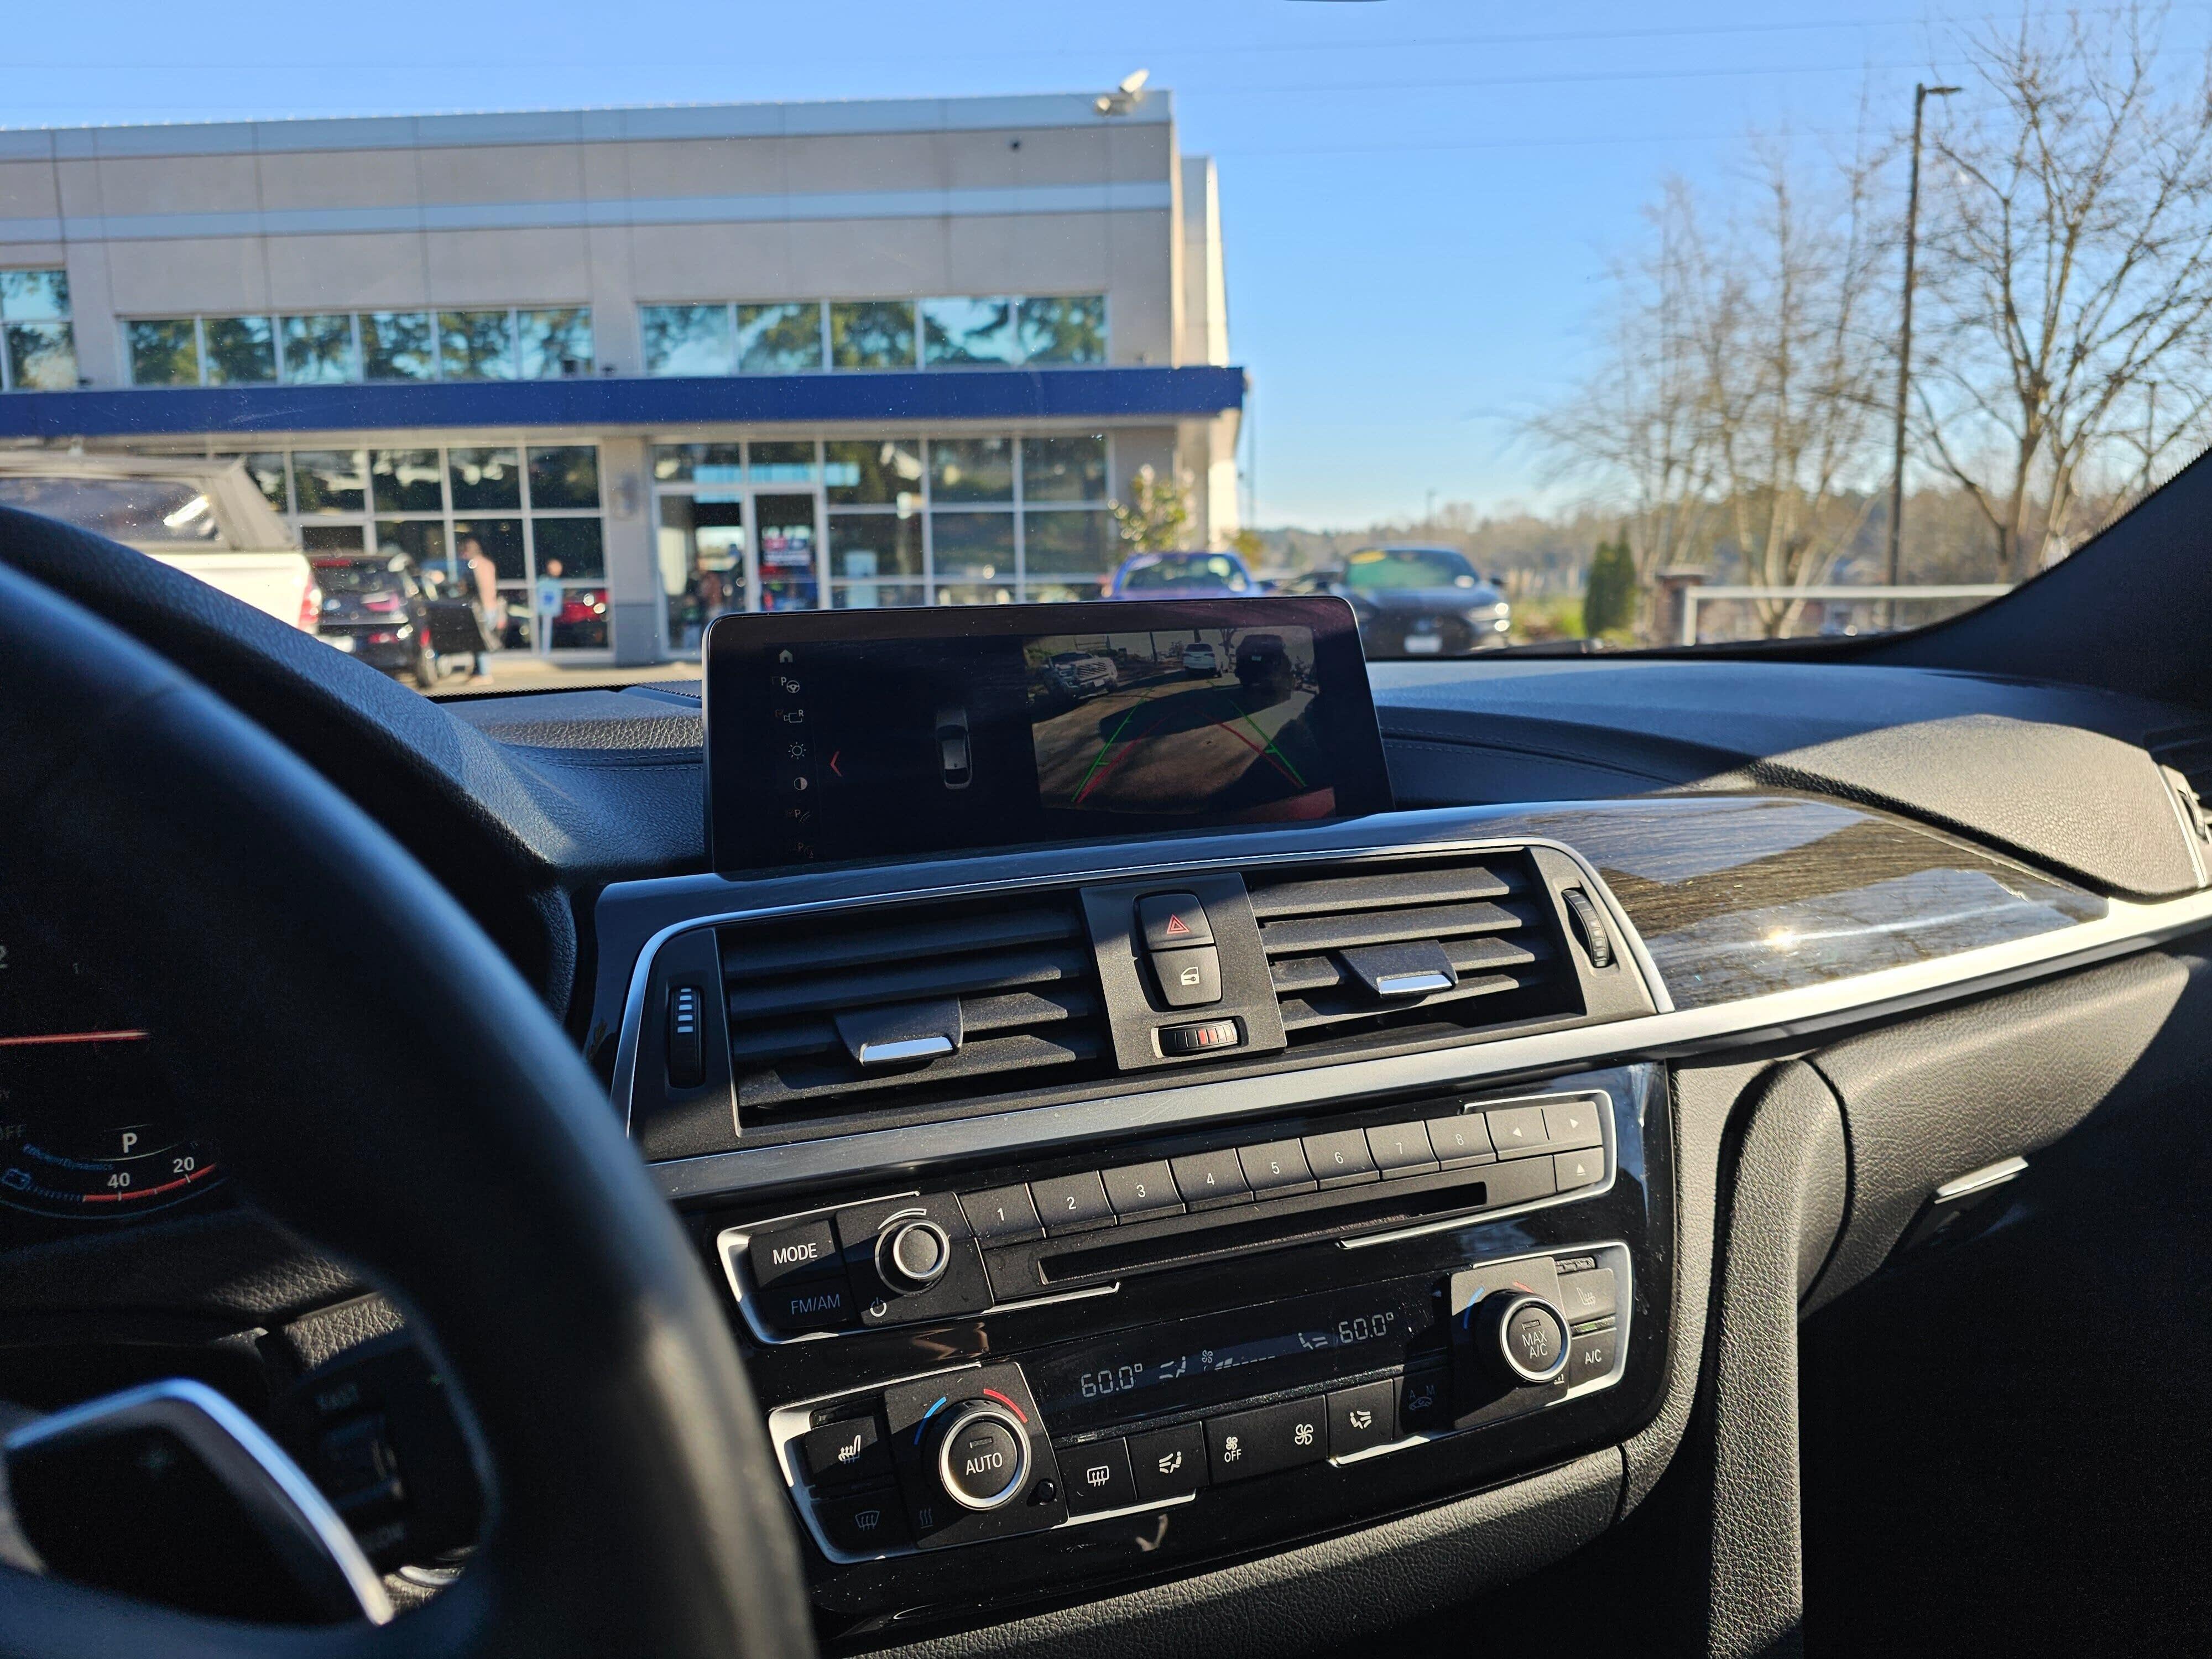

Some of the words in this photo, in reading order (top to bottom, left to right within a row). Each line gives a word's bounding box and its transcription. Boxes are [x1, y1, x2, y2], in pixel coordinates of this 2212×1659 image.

[781, 676, 787, 686] P
[798, 709, 805, 718] R
[795, 809, 801, 818] P
[122, 1132, 138, 1154] P
[1455, 1133, 1464, 1146] 8
[1395, 1142, 1404, 1155] 7
[1334, 1151, 1344, 1164] 6
[173, 1156, 195, 1174] 20
[1271, 1161, 1280, 1175] 5
[107, 1172, 131, 1188] 40
[1207, 1172, 1215, 1185] 4
[1136, 1184, 1146, 1198] 3
[1067, 1196, 1077, 1210] 2
[997, 1208, 1005, 1221] 1
[773, 1243, 818, 1265] MODE
[791, 1294, 841, 1315] FM/AM
[1521, 1329, 1548, 1347] MAX
[1530, 1343, 1548, 1359] A/C
[1585, 1349, 1602, 1365] A/C
[1409, 1389, 1416, 1400] A
[1224, 1448, 1242, 1463] OFF
[966, 1452, 1003, 1475] AUTO
